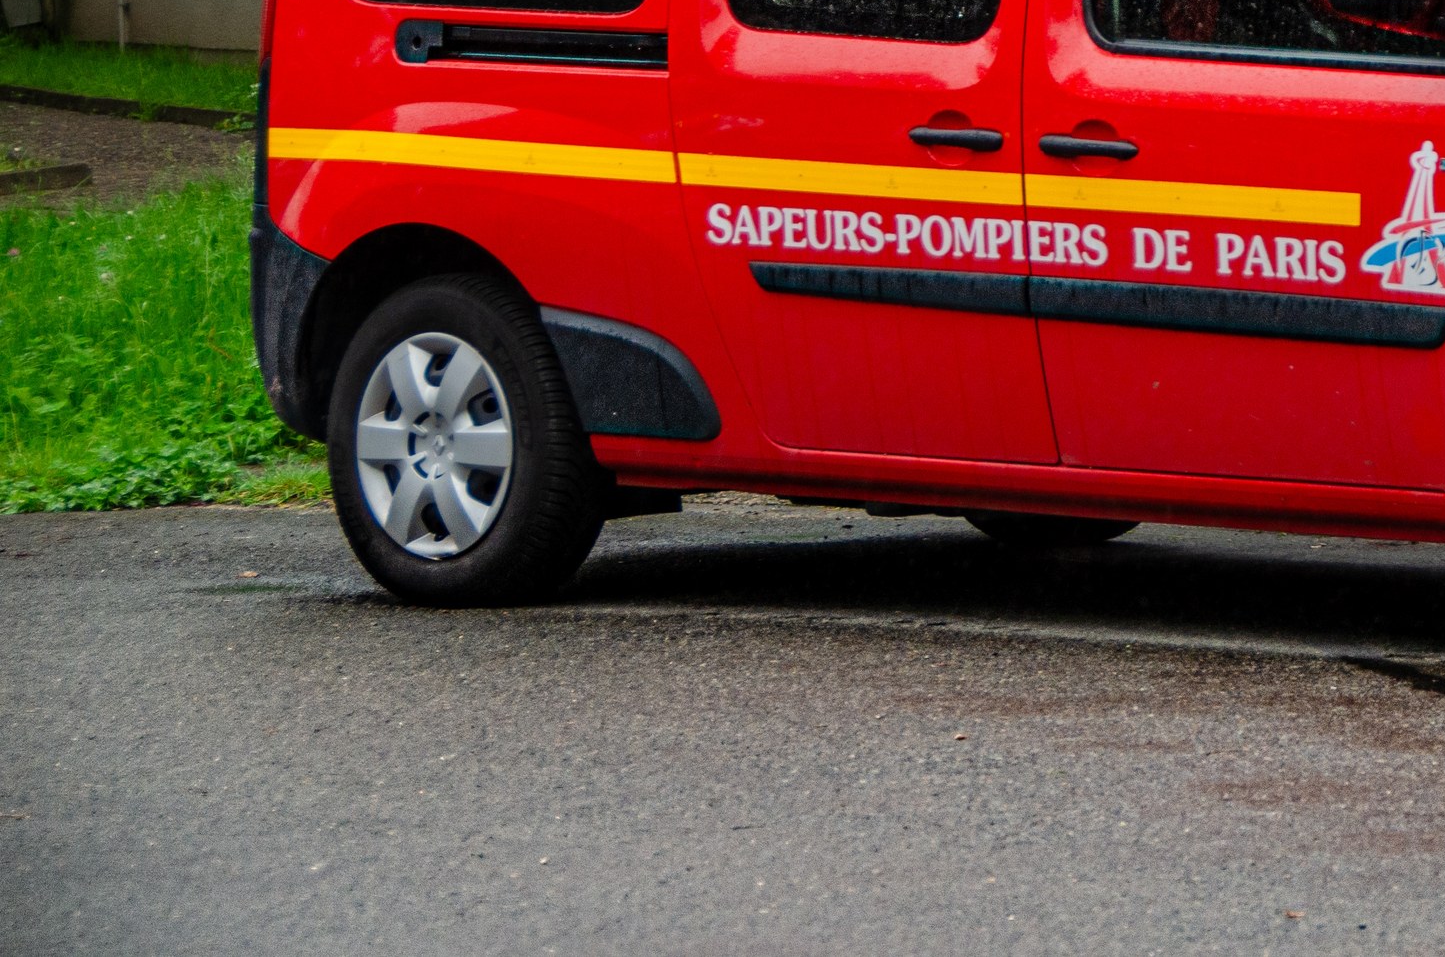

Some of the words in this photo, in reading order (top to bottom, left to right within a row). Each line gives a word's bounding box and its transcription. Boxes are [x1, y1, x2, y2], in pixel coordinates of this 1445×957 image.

[707, 203, 1108, 267] SAPEURS-POMPIERS
[1132, 227, 1193, 272] DE
[1216, 232, 1346, 284] PARIS
